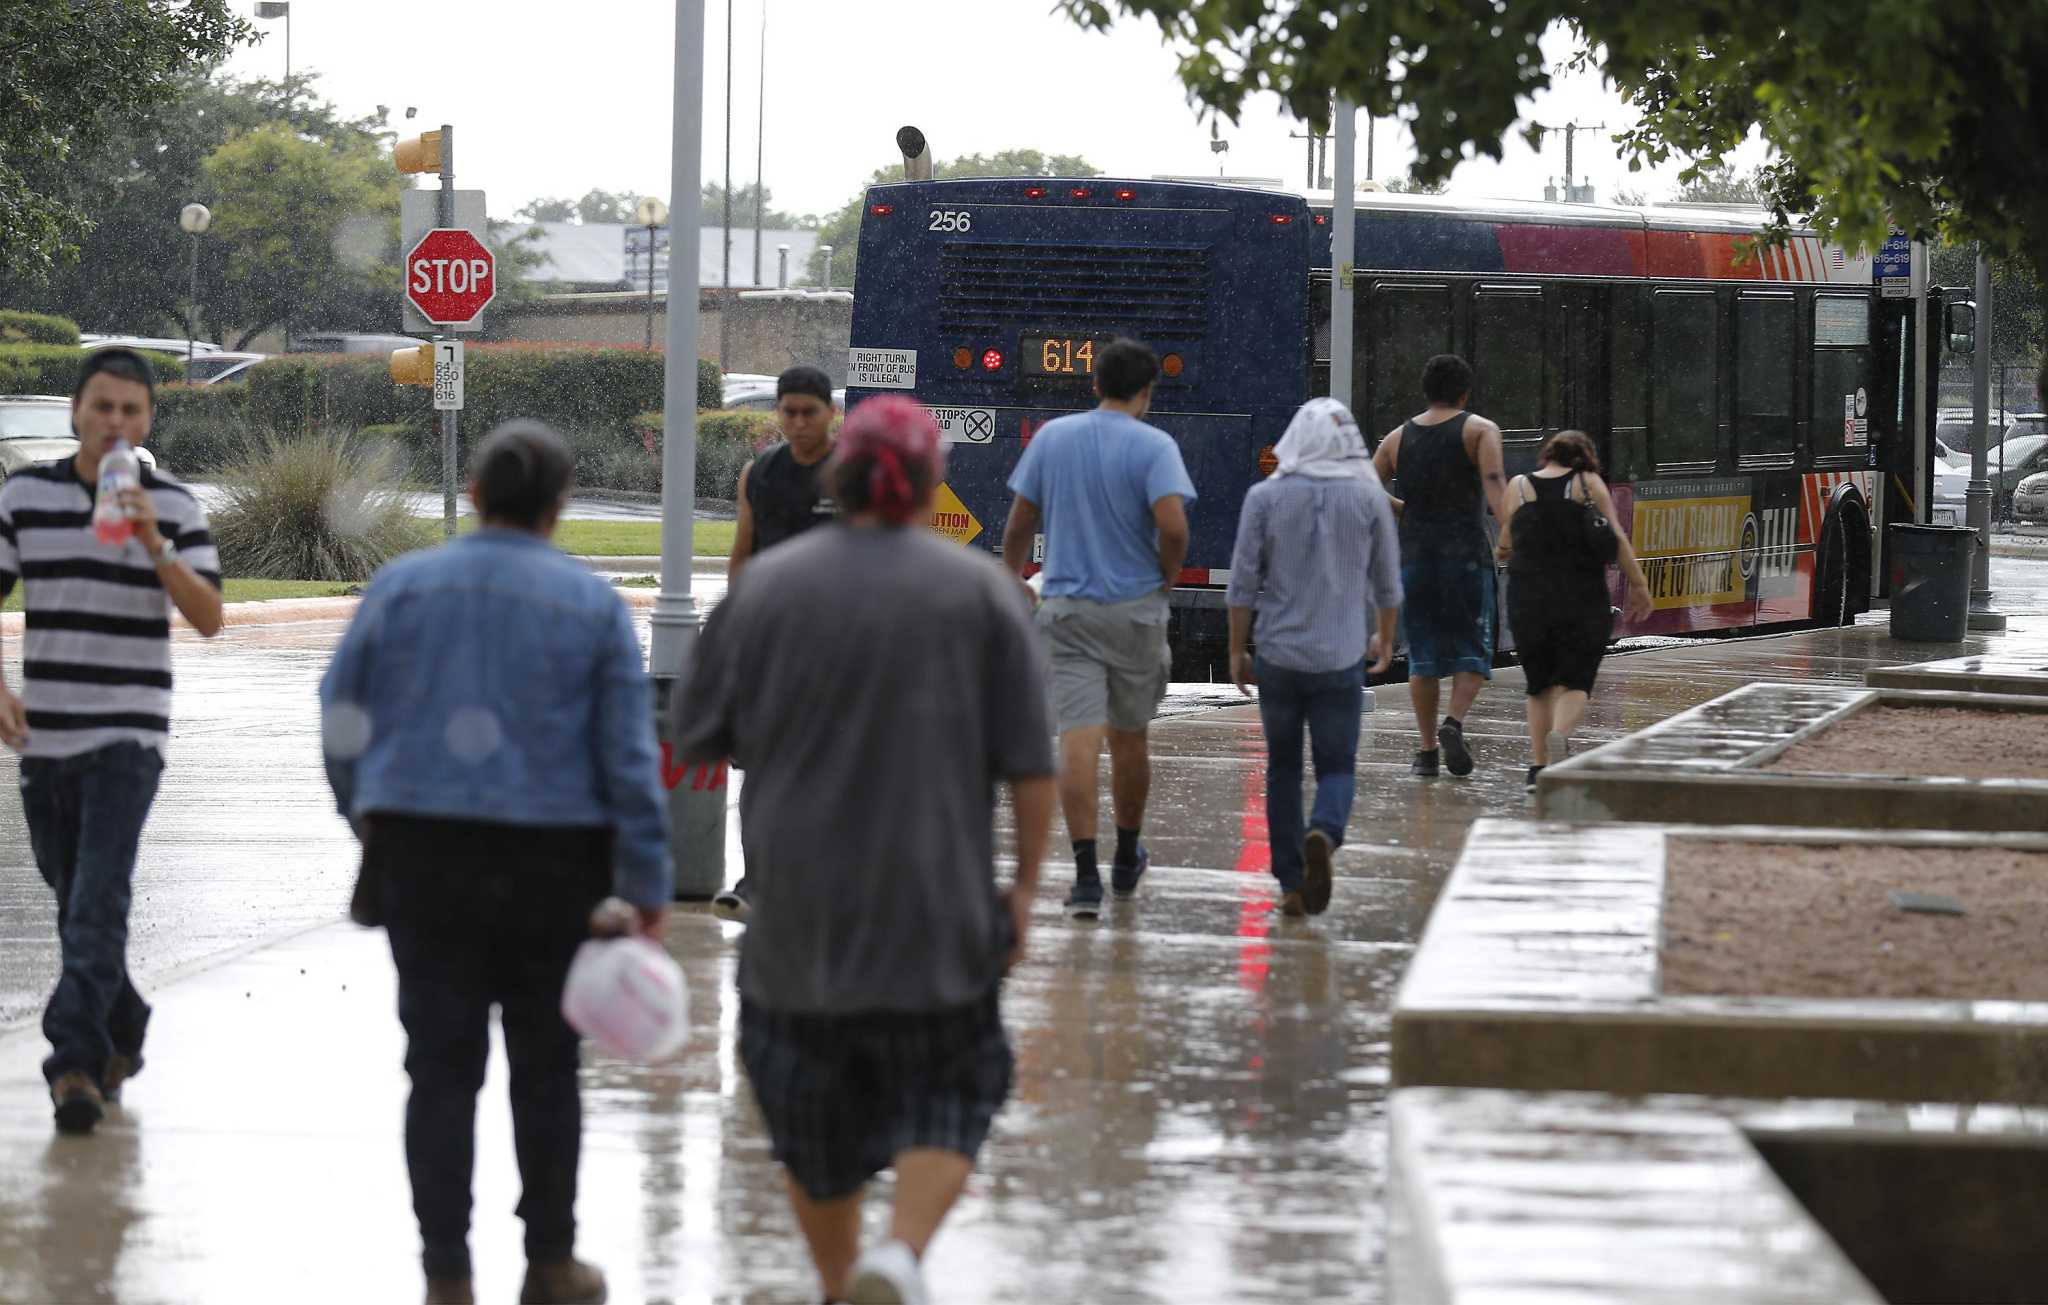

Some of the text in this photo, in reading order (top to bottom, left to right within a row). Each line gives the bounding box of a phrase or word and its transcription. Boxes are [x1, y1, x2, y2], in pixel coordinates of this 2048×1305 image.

[929, 210, 971, 232] 256
[412, 259, 489, 294] STOP
[857, 353, 907, 363] RIGHT TURN
[1043, 339, 1093, 372] 614
[848, 363, 915, 374] IN FRONT OF BUS
[859, 373, 903, 384] IS ILLEGAL
[435, 391, 456, 400] 616
[935, 409, 966, 420] STOPS
[1643, 507, 1684, 551] LEARN
[1761, 507, 1797, 578] TLU
[1670, 557, 1685, 597] TO
